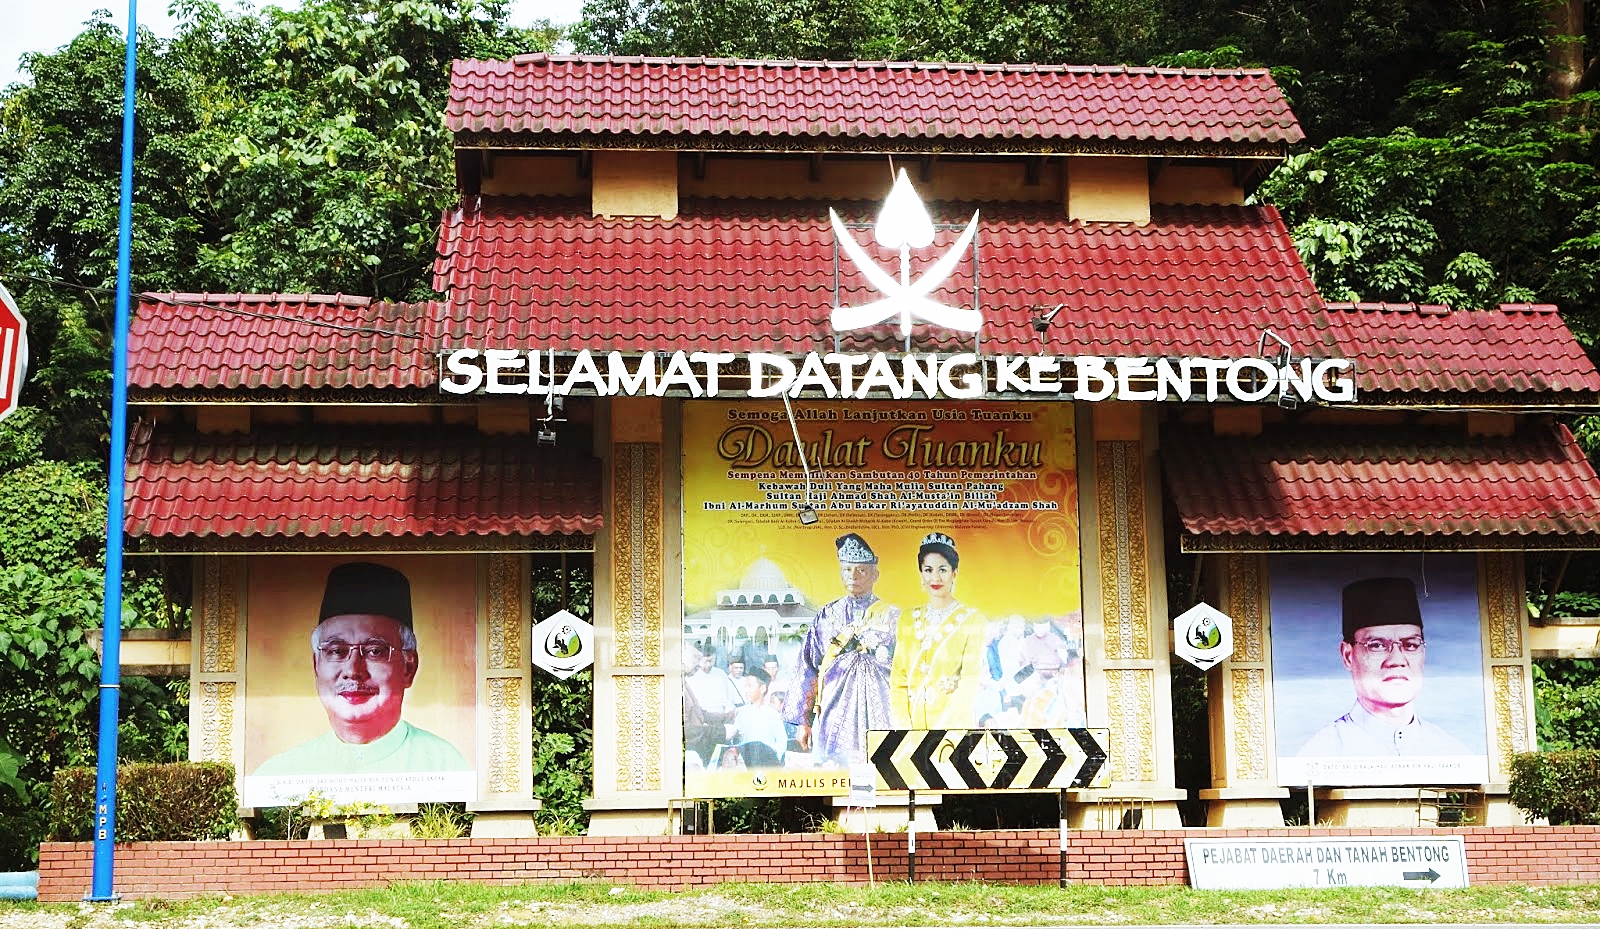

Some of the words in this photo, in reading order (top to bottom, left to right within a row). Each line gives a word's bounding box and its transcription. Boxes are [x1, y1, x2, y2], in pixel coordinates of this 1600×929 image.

[440, 348, 735, 398] SELAMAT
[745, 351, 981, 400] DATANG
[995, 355, 1061, 393] KE
[1073, 355, 1355, 402] BENTONG
[728, 409, 787, 421] Semoga
[794, 409, 837, 420] Allah
[844, 410, 927, 422] Lanjutkan
[932, 410, 966, 420] Usia
[972, 410, 1033, 420] Tuanku
[718, 424, 872, 468] Daulat
[883, 424, 1042, 468] Tuanku
[727, 471, 776, 480] Sempena
[850, 471, 904, 479] Sambutan
[908, 472, 920, 480] 40
[924, 471, 957, 479] Tahun
[961, 471, 1037, 479] Pemerintahan
[758, 482, 806, 490] Kebawah
[810, 482, 832, 490] Duli
[836, 482, 861, 492] Yang
[865, 482, 891, 490] Maha
[896, 482, 924, 490] Mulia
[928, 482, 963, 490] Sultan
[966, 482, 1004, 492] Pahang
[766, 492, 801, 500] Sultan
[830, 492, 867, 500] Ahmad
[870, 492, 896, 500] Shah
[900, 492, 961, 500] Al-Musta'in
[964, 492, 996, 500] Billah
[703, 502, 725, 510] Ibni
[729, 502, 788, 510] Al-Marhum
[830, 502, 853, 510] Abu
[855, 502, 887, 510] Bakar
[890, 501, 958, 511] Ri'ayatuddin
[962, 501, 1029, 510] Al-Mu'adzam
[1032, 501, 1058, 510] Shah
[778, 779, 825, 788] MAJLIS
[1203, 848, 1257, 864] PEJABAT
[1262, 847, 1313, 864] DAERAH
[1317, 847, 1342, 863] DAN
[1346, 846, 1387, 863] TANAH
[1392, 845, 1450, 863] BENTONG
[1313, 869, 1319, 885] 7
[1327, 869, 1347, 885] Km
